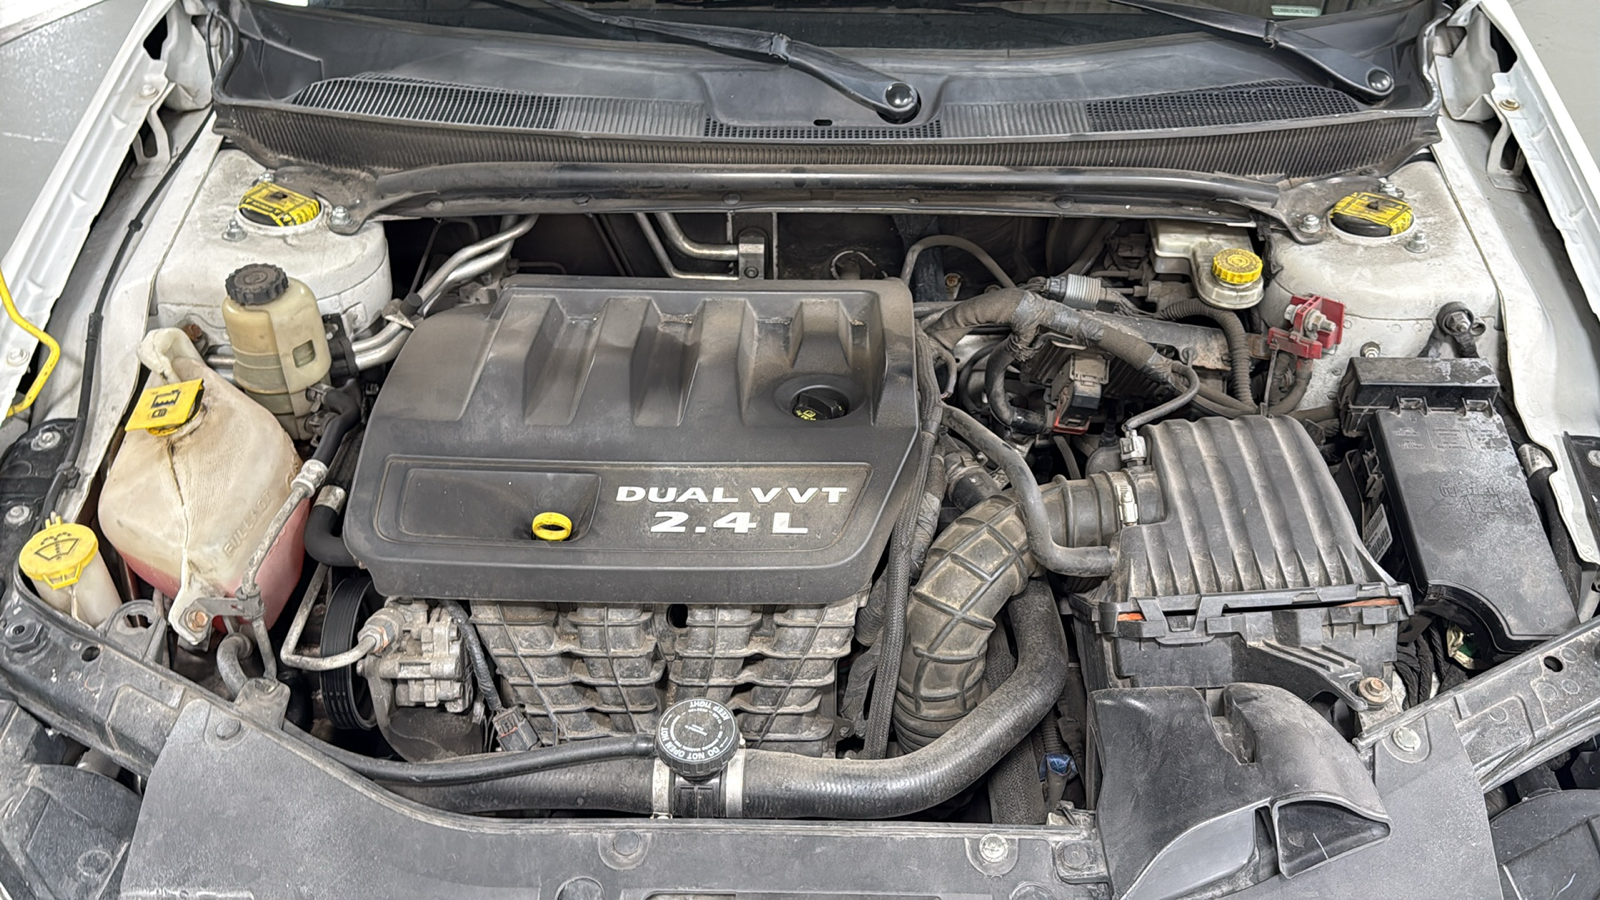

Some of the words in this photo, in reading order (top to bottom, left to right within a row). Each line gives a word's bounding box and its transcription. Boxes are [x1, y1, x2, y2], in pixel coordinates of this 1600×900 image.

[615, 485, 739, 503] DUAL
[750, 486, 848, 504] VVT
[650, 511, 757, 534] 2.4
[771, 512, 809, 534] L
[689, 701, 712, 709] TIGHT
[712, 705, 731, 721] KEEP
[660, 726, 669, 742] HOT
[664, 741, 686, 758] OPEN
[686, 752, 705, 760] NOT
[707, 746, 720, 757] DO
